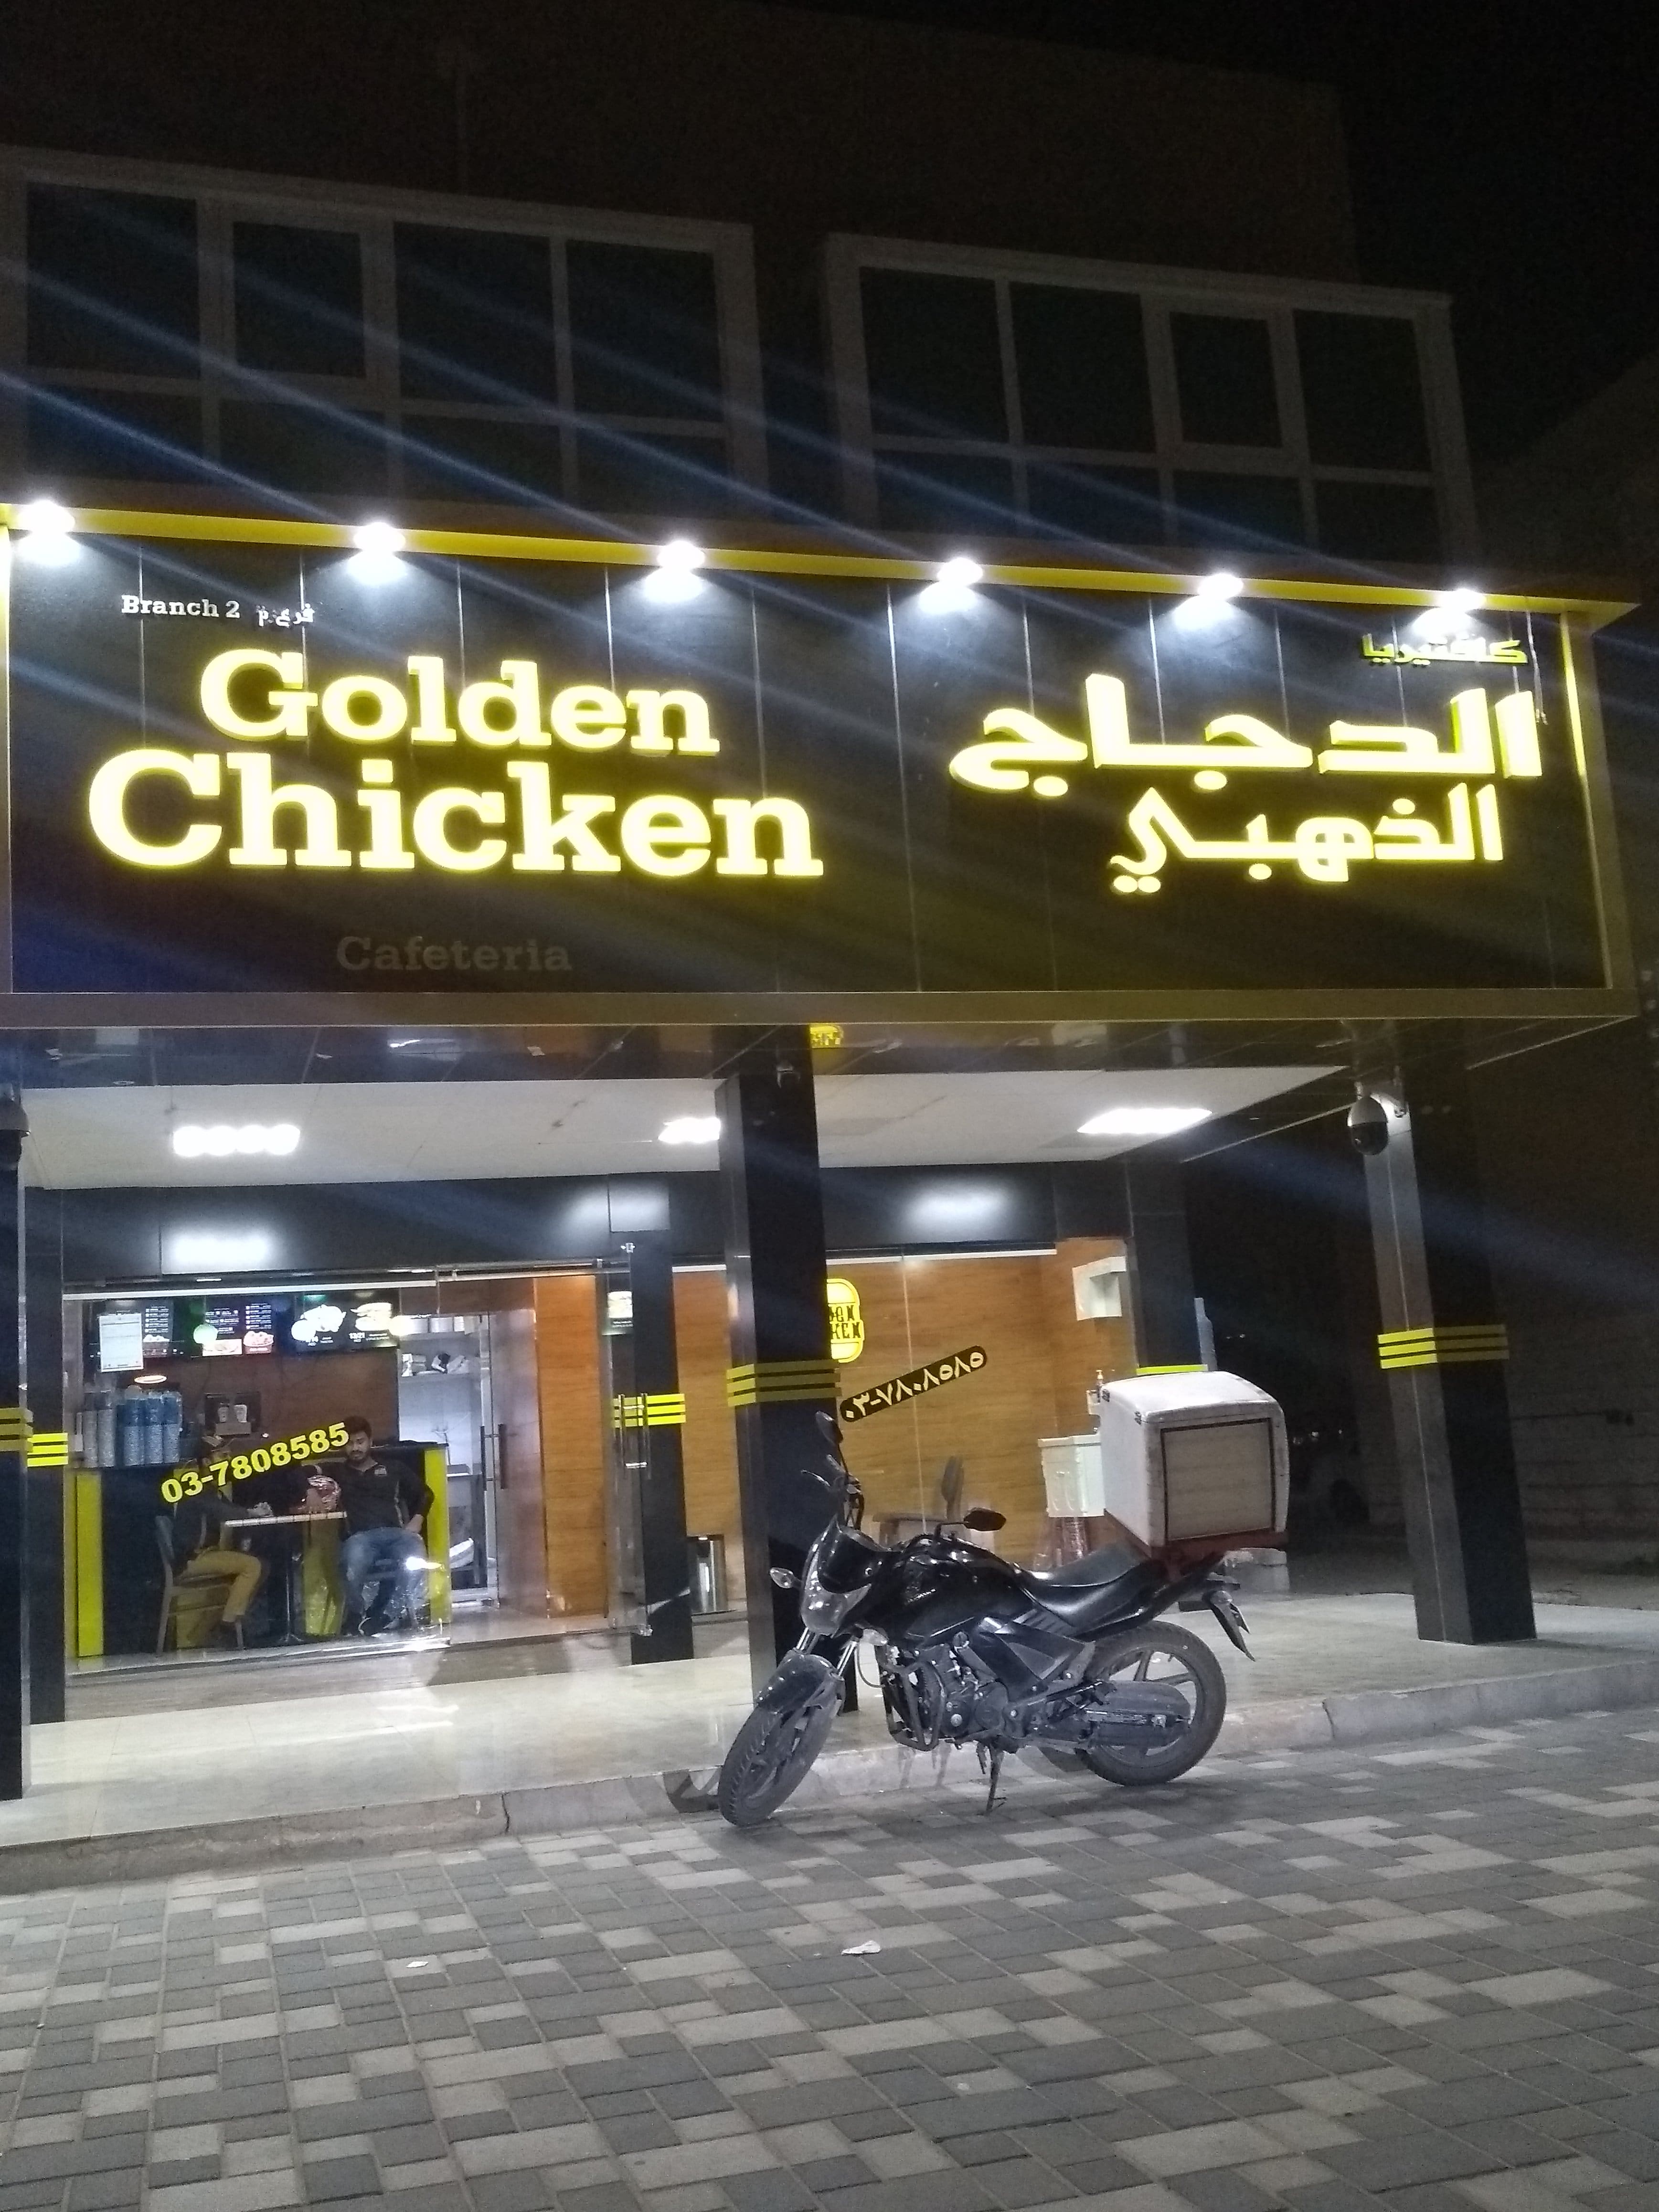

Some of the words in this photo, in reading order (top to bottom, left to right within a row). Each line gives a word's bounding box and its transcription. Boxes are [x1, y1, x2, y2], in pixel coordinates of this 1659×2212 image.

[121, 595, 219, 618] Branch
[225, 600, 240, 619] 2
[200, 648, 720, 755] Golden
[949, 673, 1543, 798] الدجاج
[87, 747, 824, 877] Chicken
[1108, 781, 1504, 894] الذهبي
[336, 936, 573, 971] Cafeteria
[161, 1422, 350, 1503] 03-7808585
